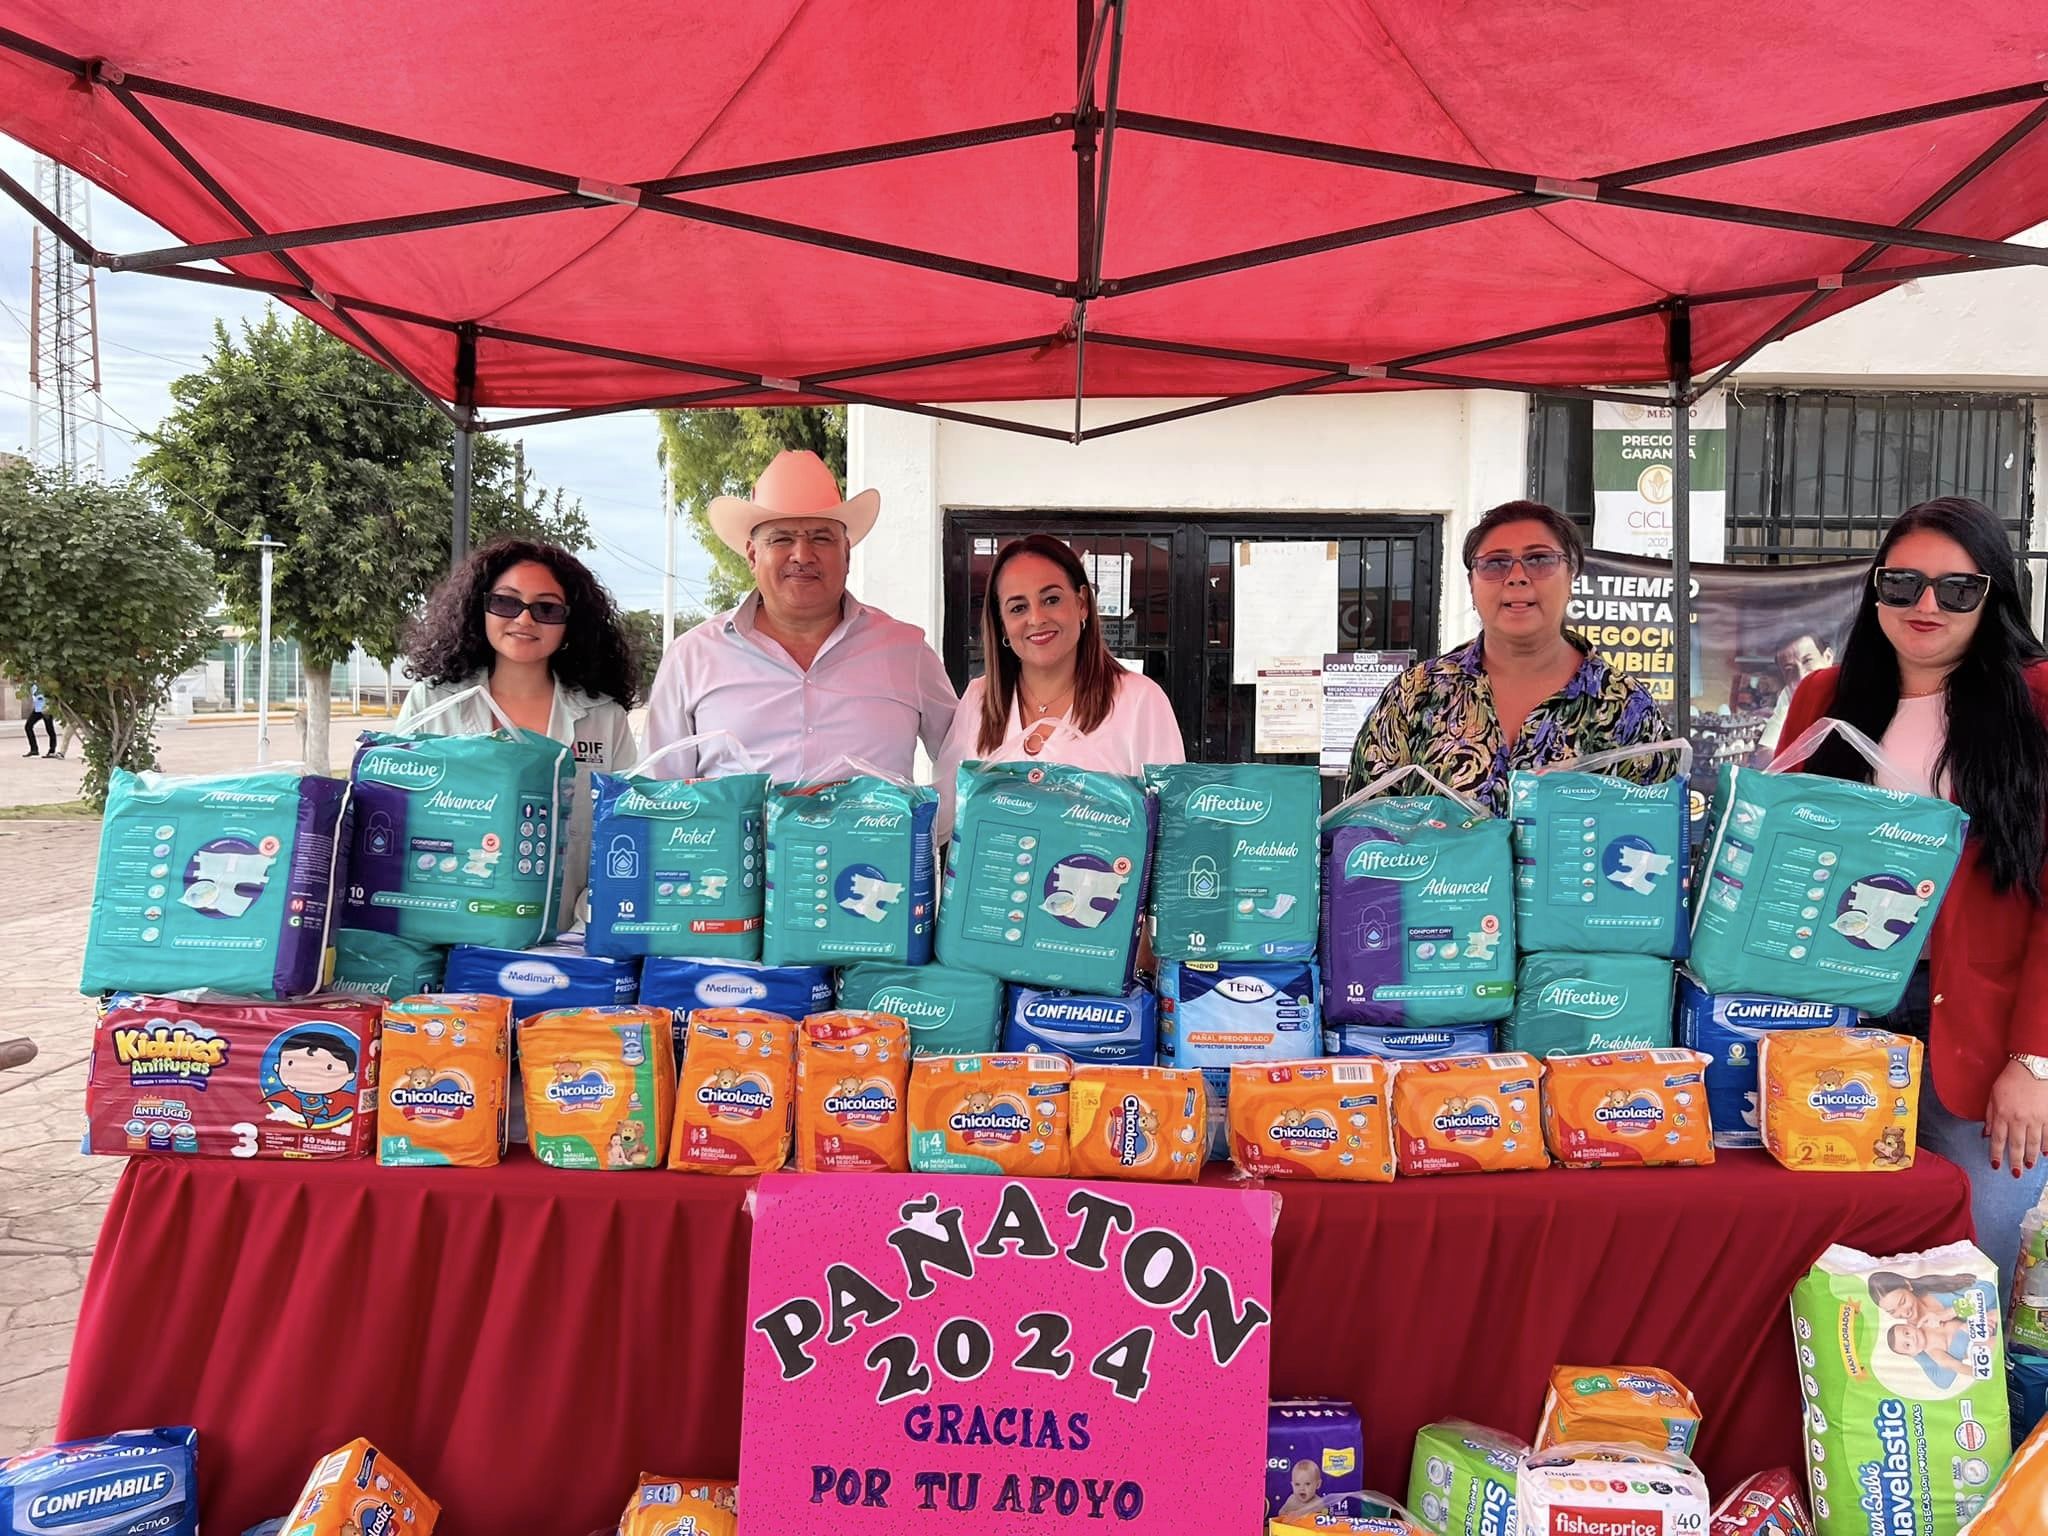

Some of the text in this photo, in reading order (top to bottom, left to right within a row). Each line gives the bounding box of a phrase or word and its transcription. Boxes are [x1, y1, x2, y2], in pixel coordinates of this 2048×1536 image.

[1621, 434, 1680, 447] PRECIO
[1621, 448, 1697, 460] GARANA
[1627, 511, 1684, 529] CICL
[1567, 625, 1678, 648] NEGOCI
[1325, 663, 1405, 673] CONVOCATORIA
[577, 741, 603, 754] DIF
[363, 755, 439, 778] Affective
[423, 790, 498, 812] Advanced
[1622, 786, 1670, 801] Protect
[991, 794, 1033, 809] Affective
[1191, 793, 1265, 813] Affective
[854, 814, 904, 829] Protect
[1060, 803, 1132, 827] Advanced
[1793, 808, 1837, 825] Affective
[668, 826, 717, 846] Protect
[1868, 821, 1948, 849] Advanced
[1233, 839, 1299, 858] Predoblado
[1351, 852, 1430, 870] Affective
[349, 886, 365, 899] 10
[1418, 875, 1492, 897] Advanced
[291, 898, 305, 912] M
[468, 901, 480, 913] G
[515, 904, 526, 915] G
[618, 901, 634, 913] 10
[914, 905, 925, 916] M
[289, 915, 301, 927] G
[692, 920, 706, 932] M
[743, 919, 753, 931] M
[914, 923, 923, 934] G
[1187, 932, 1206, 946] 10
[1264, 943, 1275, 954] U
[333, 974, 399, 995] dvanced
[508, 970, 556, 984] Medimart
[705, 983, 753, 995] Medimart
[1227, 982, 1264, 994] TENA
[1347, 984, 1364, 997] 10
[1476, 985, 1486, 996] G
[872, 993, 947, 1018] Affective
[1549, 988, 1620, 1008] Affective
[115, 1028, 227, 1065] Kiddies
[1586, 1033, 1655, 1050] Predoblado
[1093, 1046, 1127, 1056] ACTIVO
[131, 1059, 210, 1077] Antifugas
[391, 1089, 474, 1107] Chicolastic
[547, 1083, 615, 1098] Chicolastic
[698, 1087, 773, 1108] Chicolastic
[825, 1096, 897, 1113] Chicolastic
[1809, 1093, 1877, 1107] Chicolastic
[135, 1106, 189, 1119] ANTIFUGAS
[1595, 1107, 1664, 1121] Chicolastic
[950, 1114, 1030, 1130] Chicolastic
[1434, 1115, 1500, 1130] Chicolastic
[699, 1128, 708, 1139] 3
[1122, 1096, 1139, 1166] Chicolastic
[1269, 1126, 1338, 1140] Chicolastic
[1577, 1130, 1586, 1141] 3
[230, 1122, 259, 1158] 3
[397, 1137, 408, 1150] 4
[831, 1137, 840, 1148] 3
[930, 1132, 942, 1146] 4
[1417, 1139, 1426, 1150] 3
[1253, 1144, 1260, 1155] 3
[1801, 1145, 1813, 1161] 2
[543, 1151, 554, 1164] 4
[755, 1182, 1270, 1379] PAÑATON
[1841, 1306, 1852, 1353] MEJORADOS
[1976, 1323, 1987, 1338] 44
[865, 1311, 1155, 1402] 2024
[903, 1403, 1092, 1451] GRACIAS
[1912, 1404, 1925, 1436] SANAS
[1876, 1401, 1914, 1536] uavelastic
[810, 1464, 1144, 1521] POR TU APOYO
[1860, 1462, 1886, 1536] eenBebé
[1817, 1497, 1826, 1514] RN
[1920, 1492, 1933, 1522] SECAS
[127, 1516, 170, 1535] ACTIVO
[1555, 1512, 1657, 1536] fisher-price
[1677, 1513, 1701, 1529] 40
